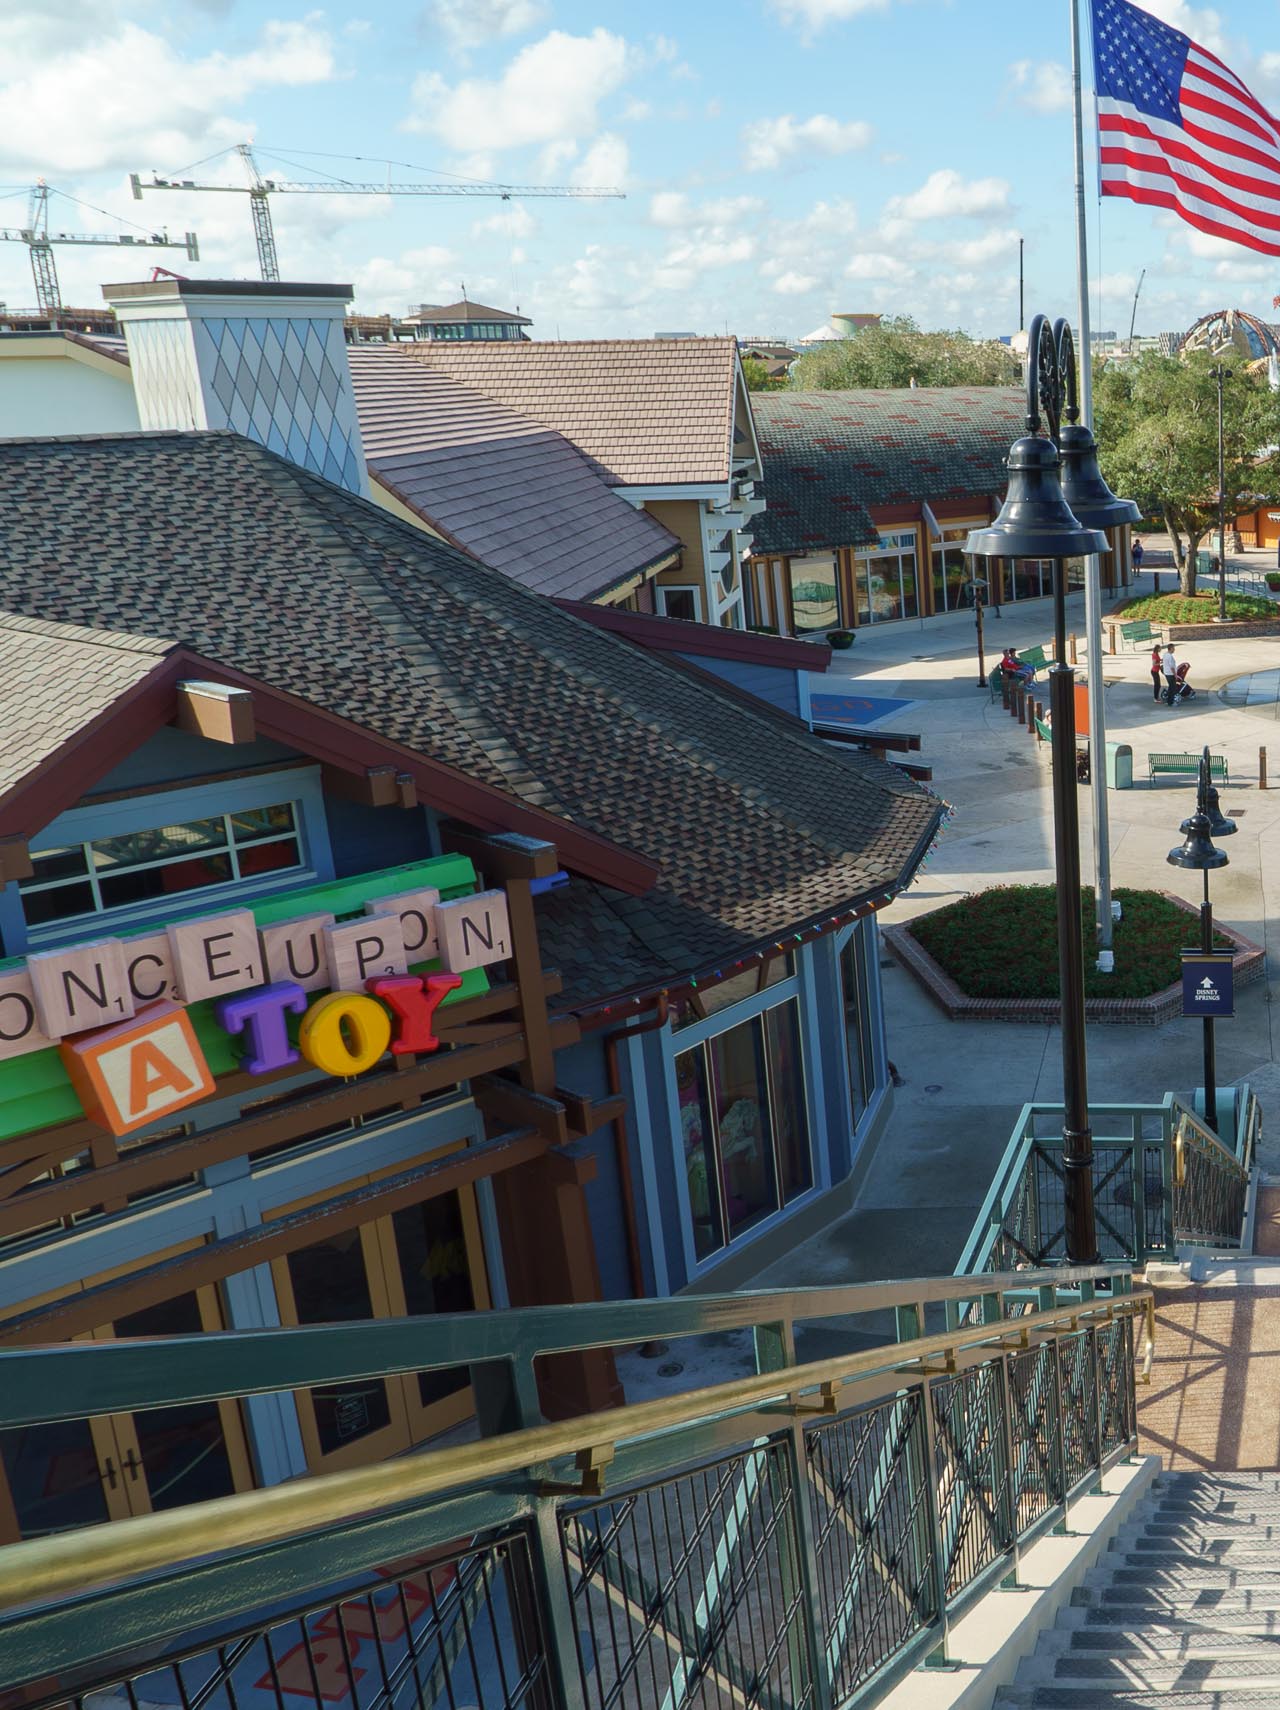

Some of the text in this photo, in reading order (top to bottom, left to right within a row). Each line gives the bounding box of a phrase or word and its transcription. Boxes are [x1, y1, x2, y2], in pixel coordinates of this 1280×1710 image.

[0, 910, 494, 1041] ONCE UPON
[130, 970, 463, 1116] A TOY
